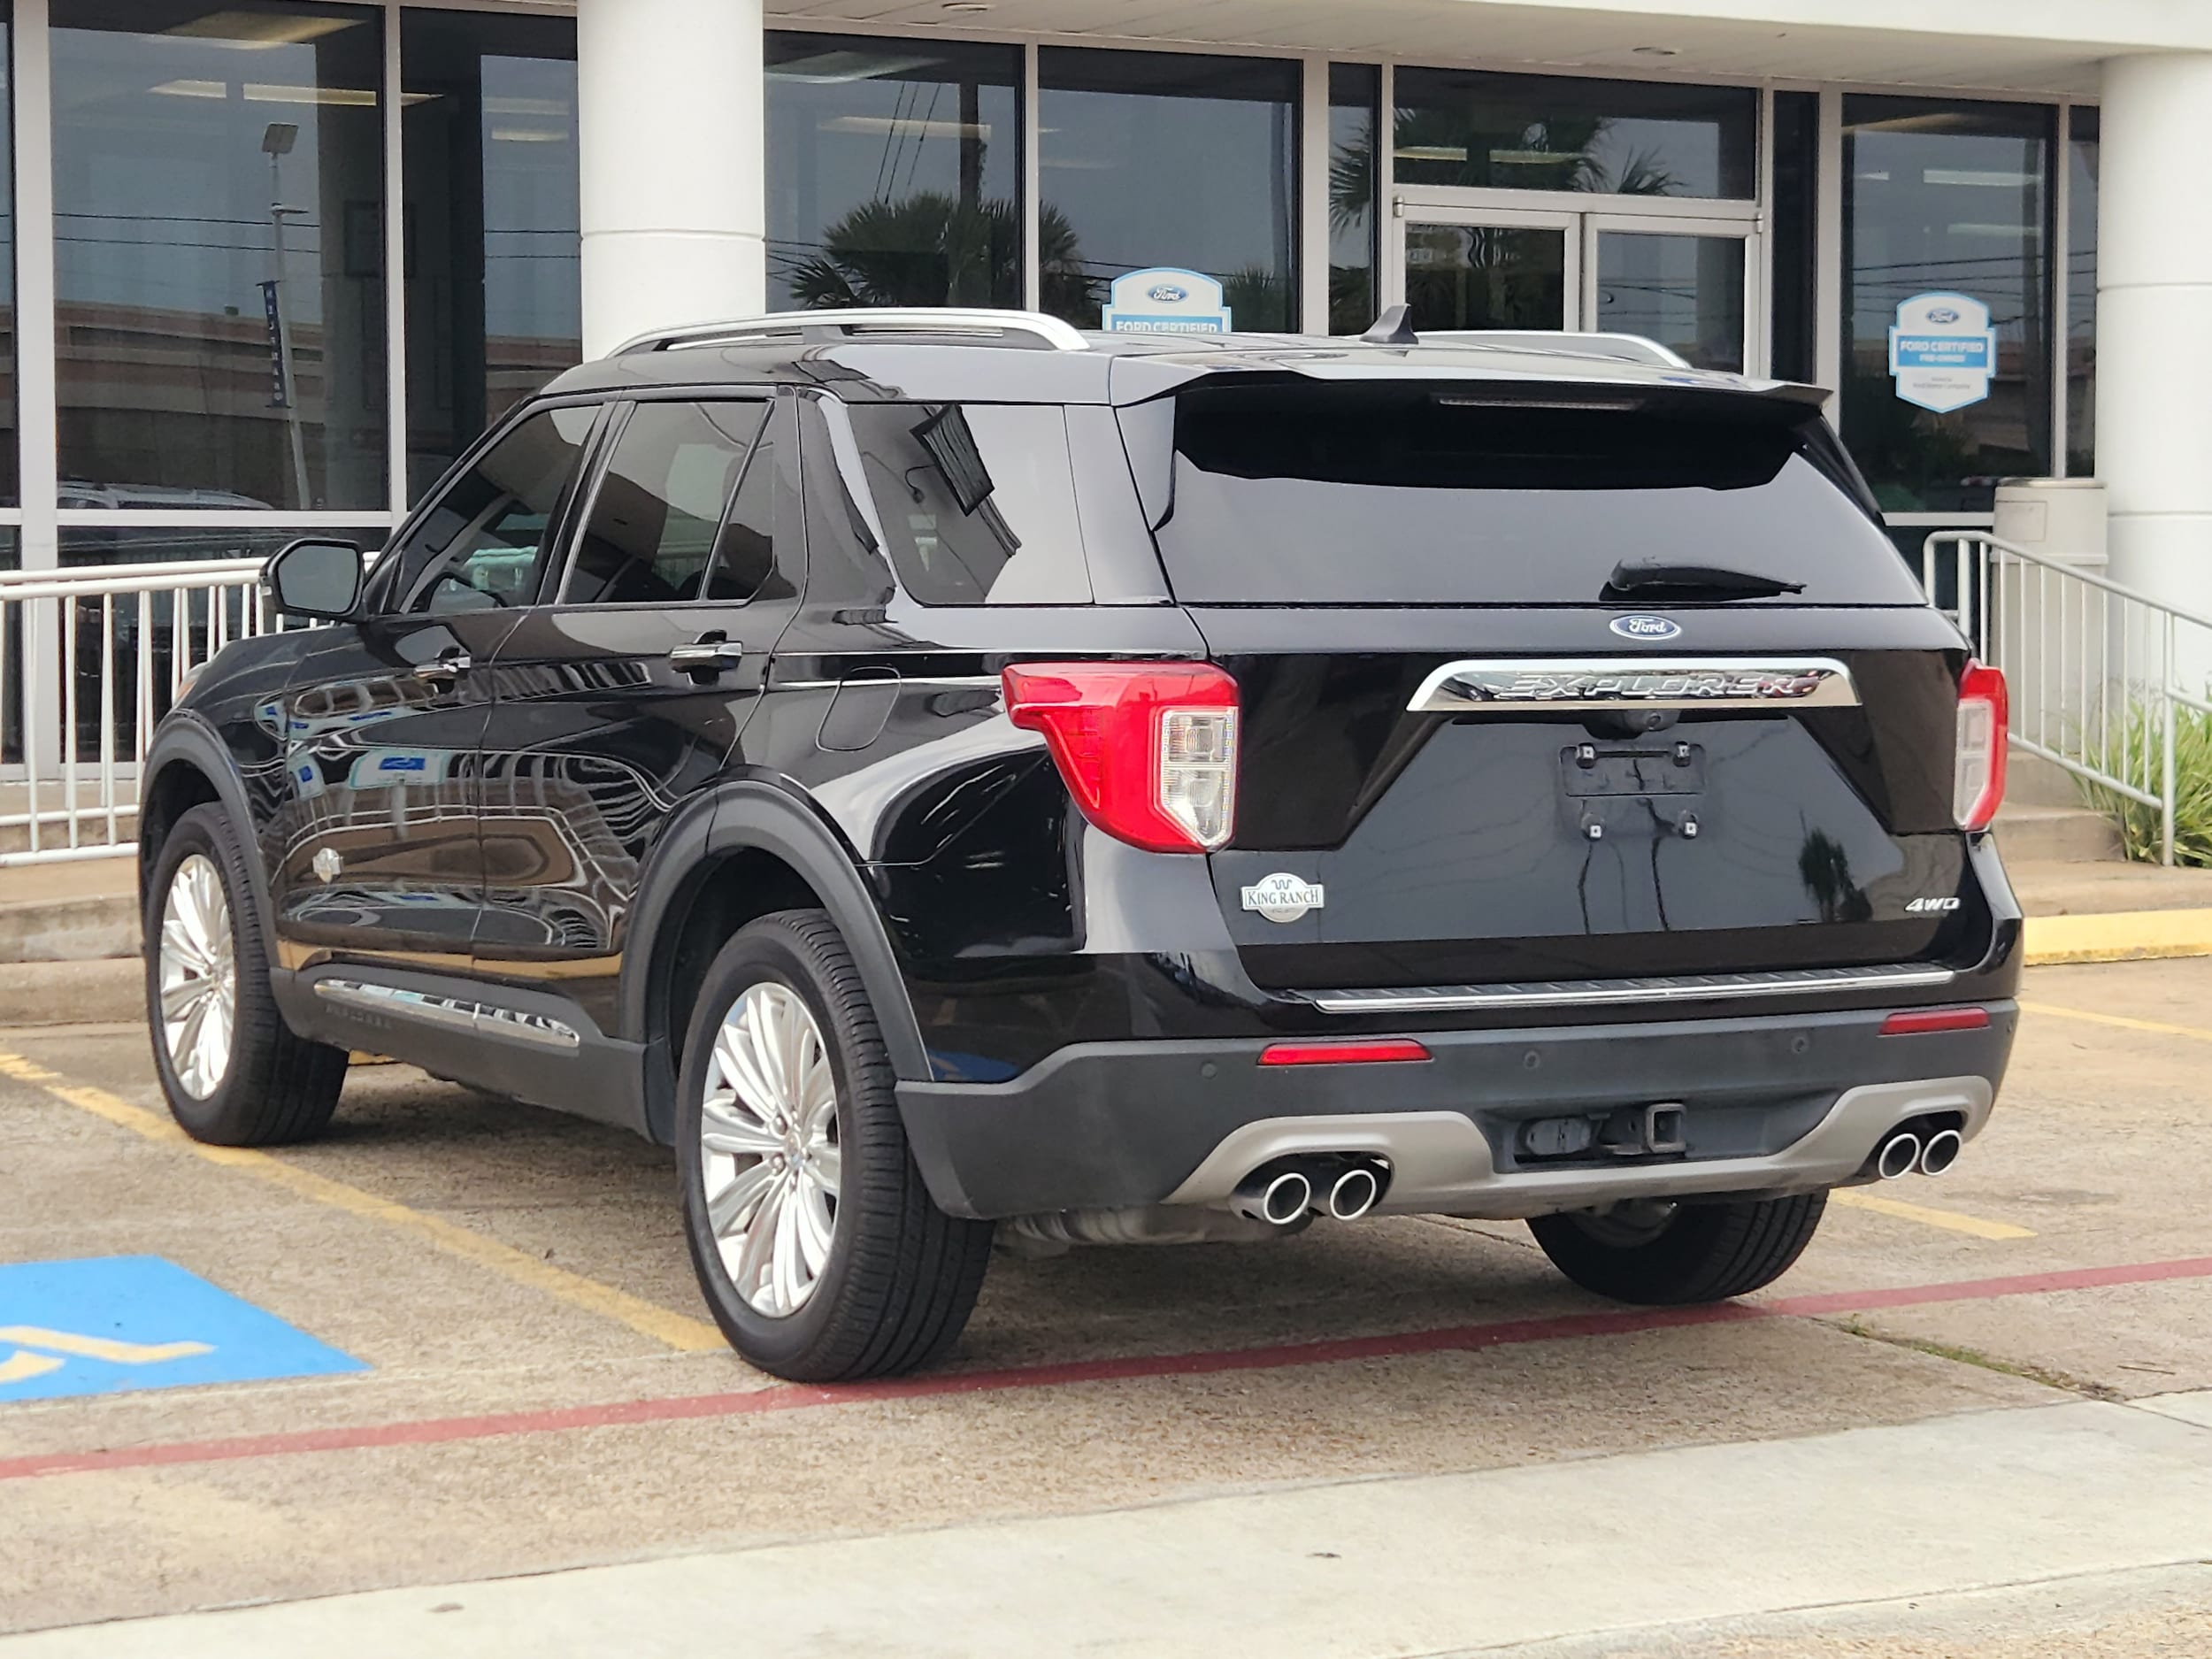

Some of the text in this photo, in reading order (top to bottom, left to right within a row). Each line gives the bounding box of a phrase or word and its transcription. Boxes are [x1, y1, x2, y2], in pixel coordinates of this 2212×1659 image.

[1154, 287, 1180, 301] Ford
[1116, 320, 1217, 333] FORD CERTIFIED
[1900, 341, 1984, 353] FORD CERTIFIED
[1629, 618, 1667, 633] Ford
[1496, 672, 1796, 698] EXPLORER
[1248, 888, 1318, 905] KING RANCH
[1905, 897, 1961, 911] 4WD
